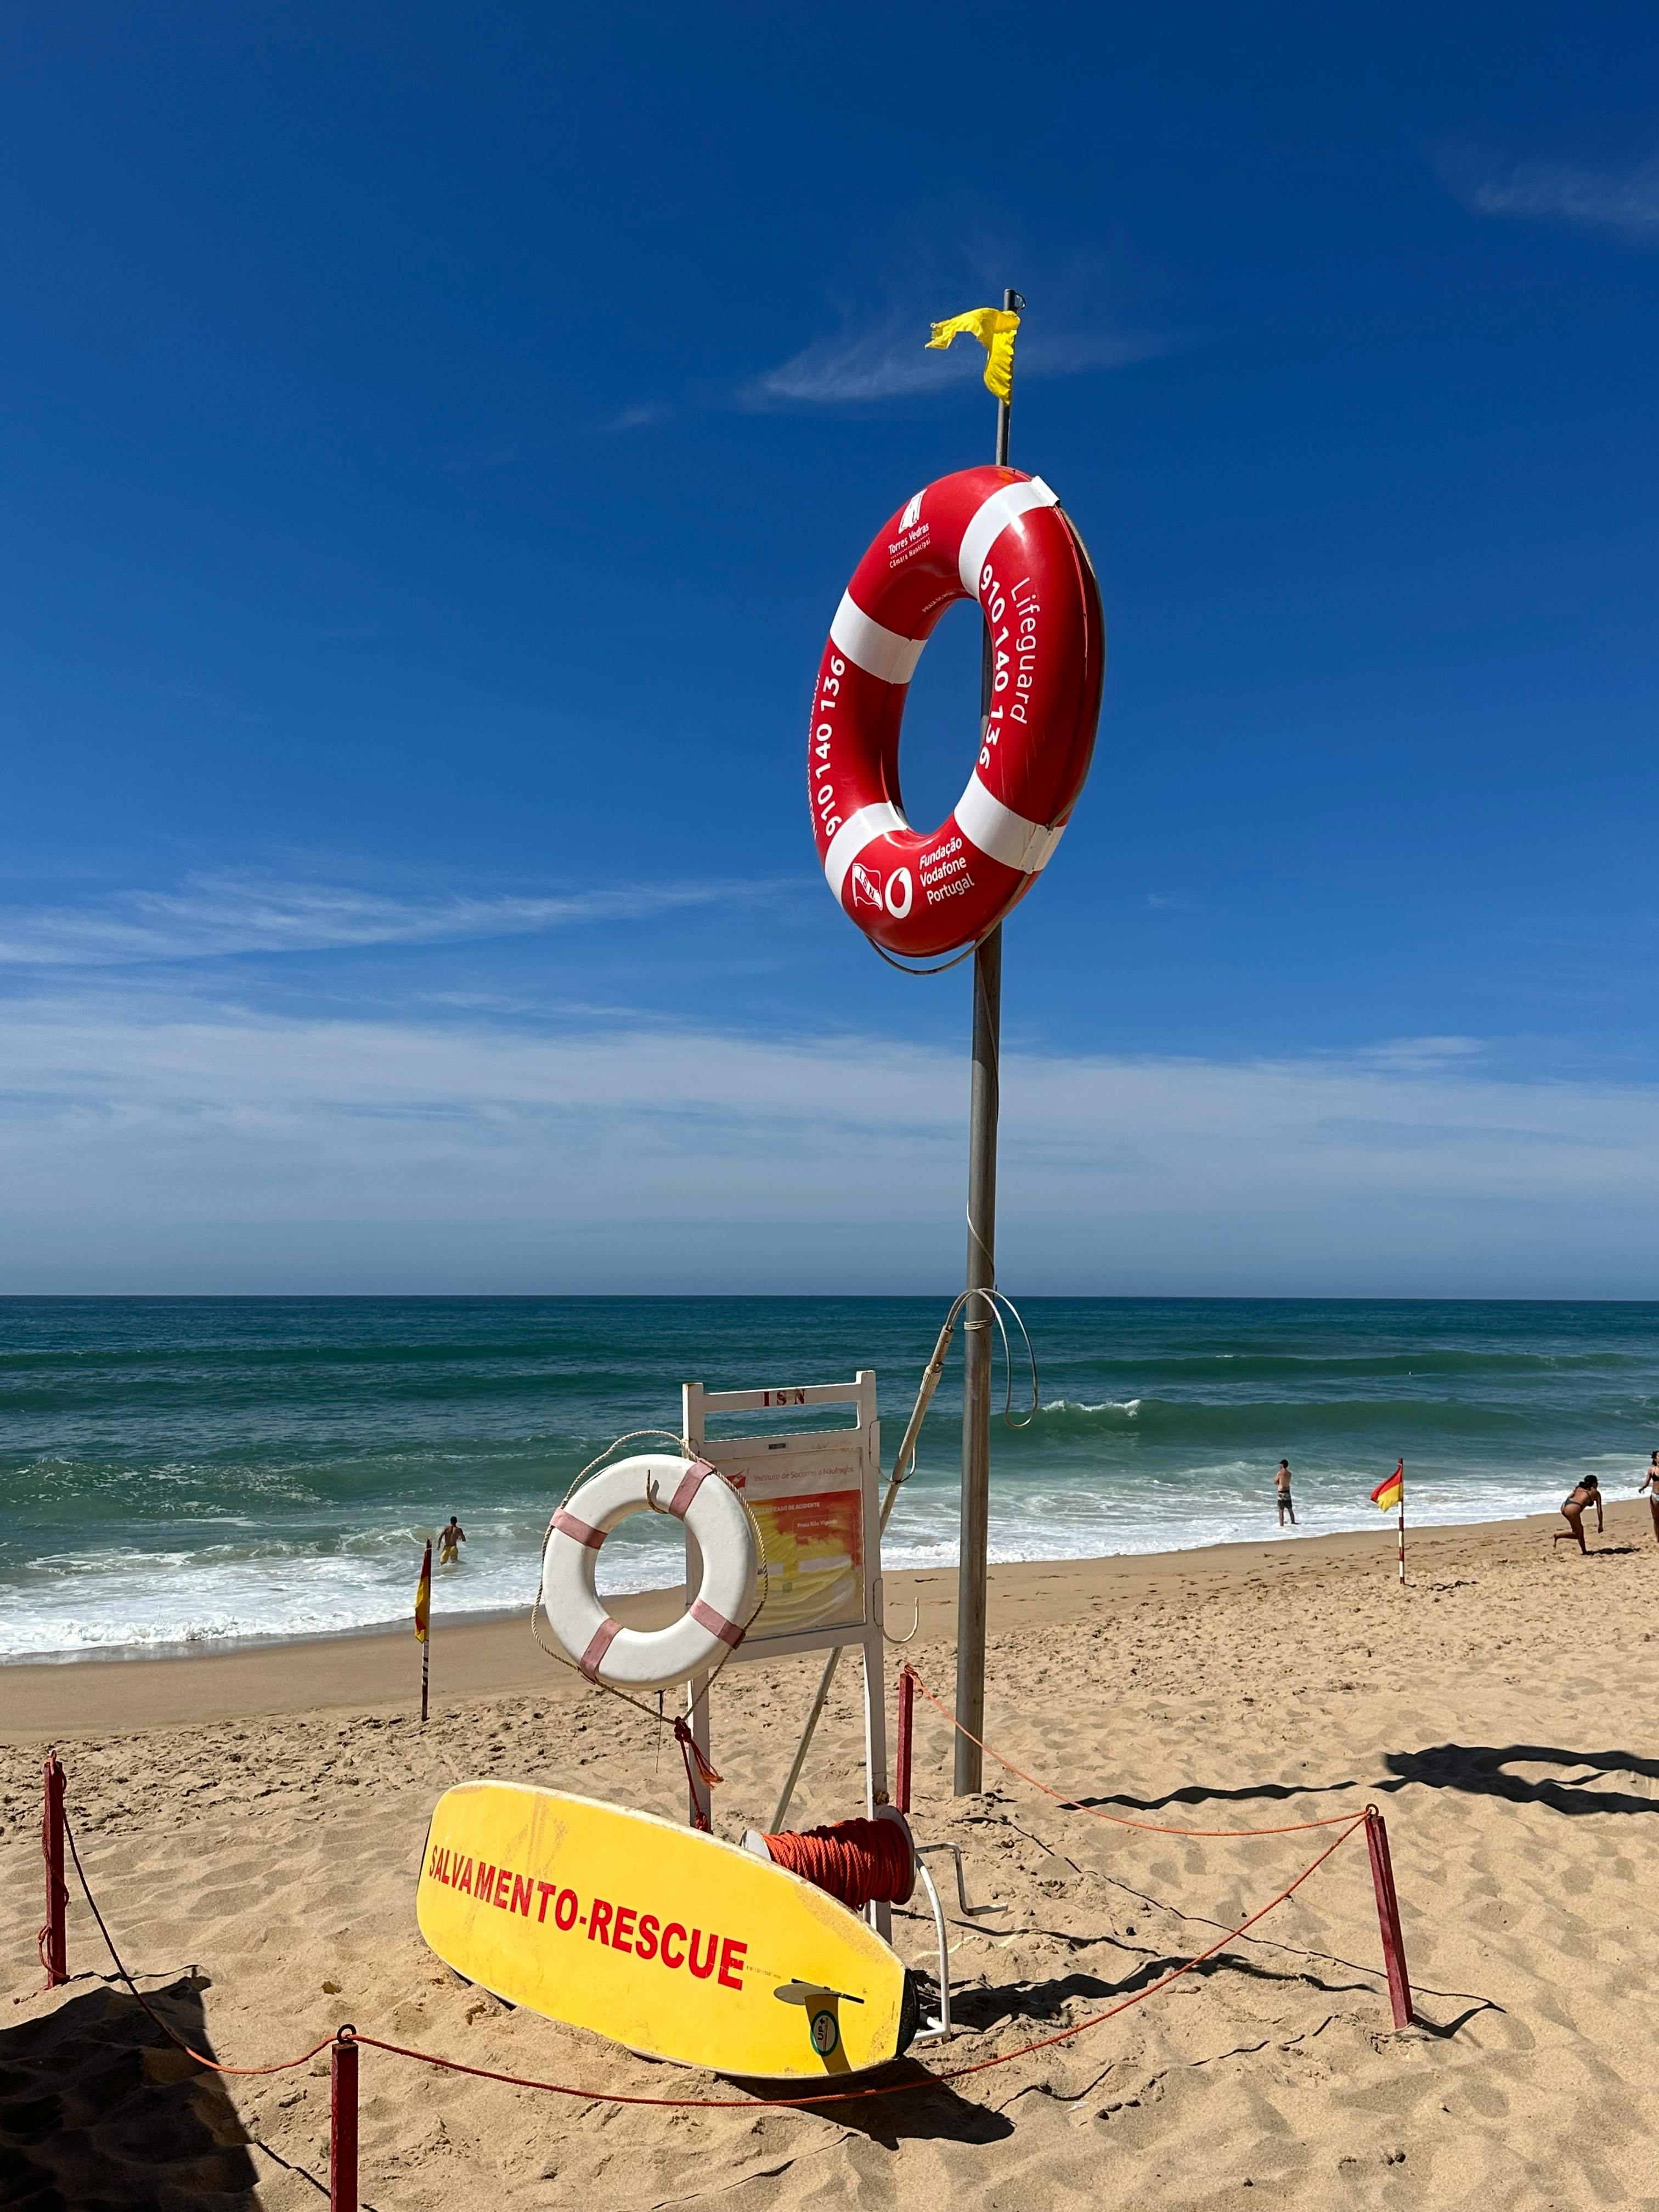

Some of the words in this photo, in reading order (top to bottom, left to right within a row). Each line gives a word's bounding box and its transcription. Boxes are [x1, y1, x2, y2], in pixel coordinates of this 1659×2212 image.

[888, 537, 908, 555] Torres
[909, 523, 929, 542] Vedras
[909, 537, 931, 557] Municipal
[980, 564, 1006, 624] 910
[995, 625, 1010, 692] 140
[1011, 577, 1041, 724] Lifeguard
[820, 654, 845, 712] 136
[815, 723, 833, 780] 140
[979, 704, 1004, 769] 136
[817, 784, 843, 837] 910
[919, 836, 962, 871] Fundação
[919, 857, 967, 888] Vodafone
[926, 872, 975, 905] Portugal
[754, 1472, 780, 1482] Instituto
[781, 1471, 789, 1480] de
[795, 1502, 821, 1510] ACIDENTE
[429, 1845, 748, 1991] SALVAMENTO-RESCUE
[817, 2025, 824, 2040] UP
